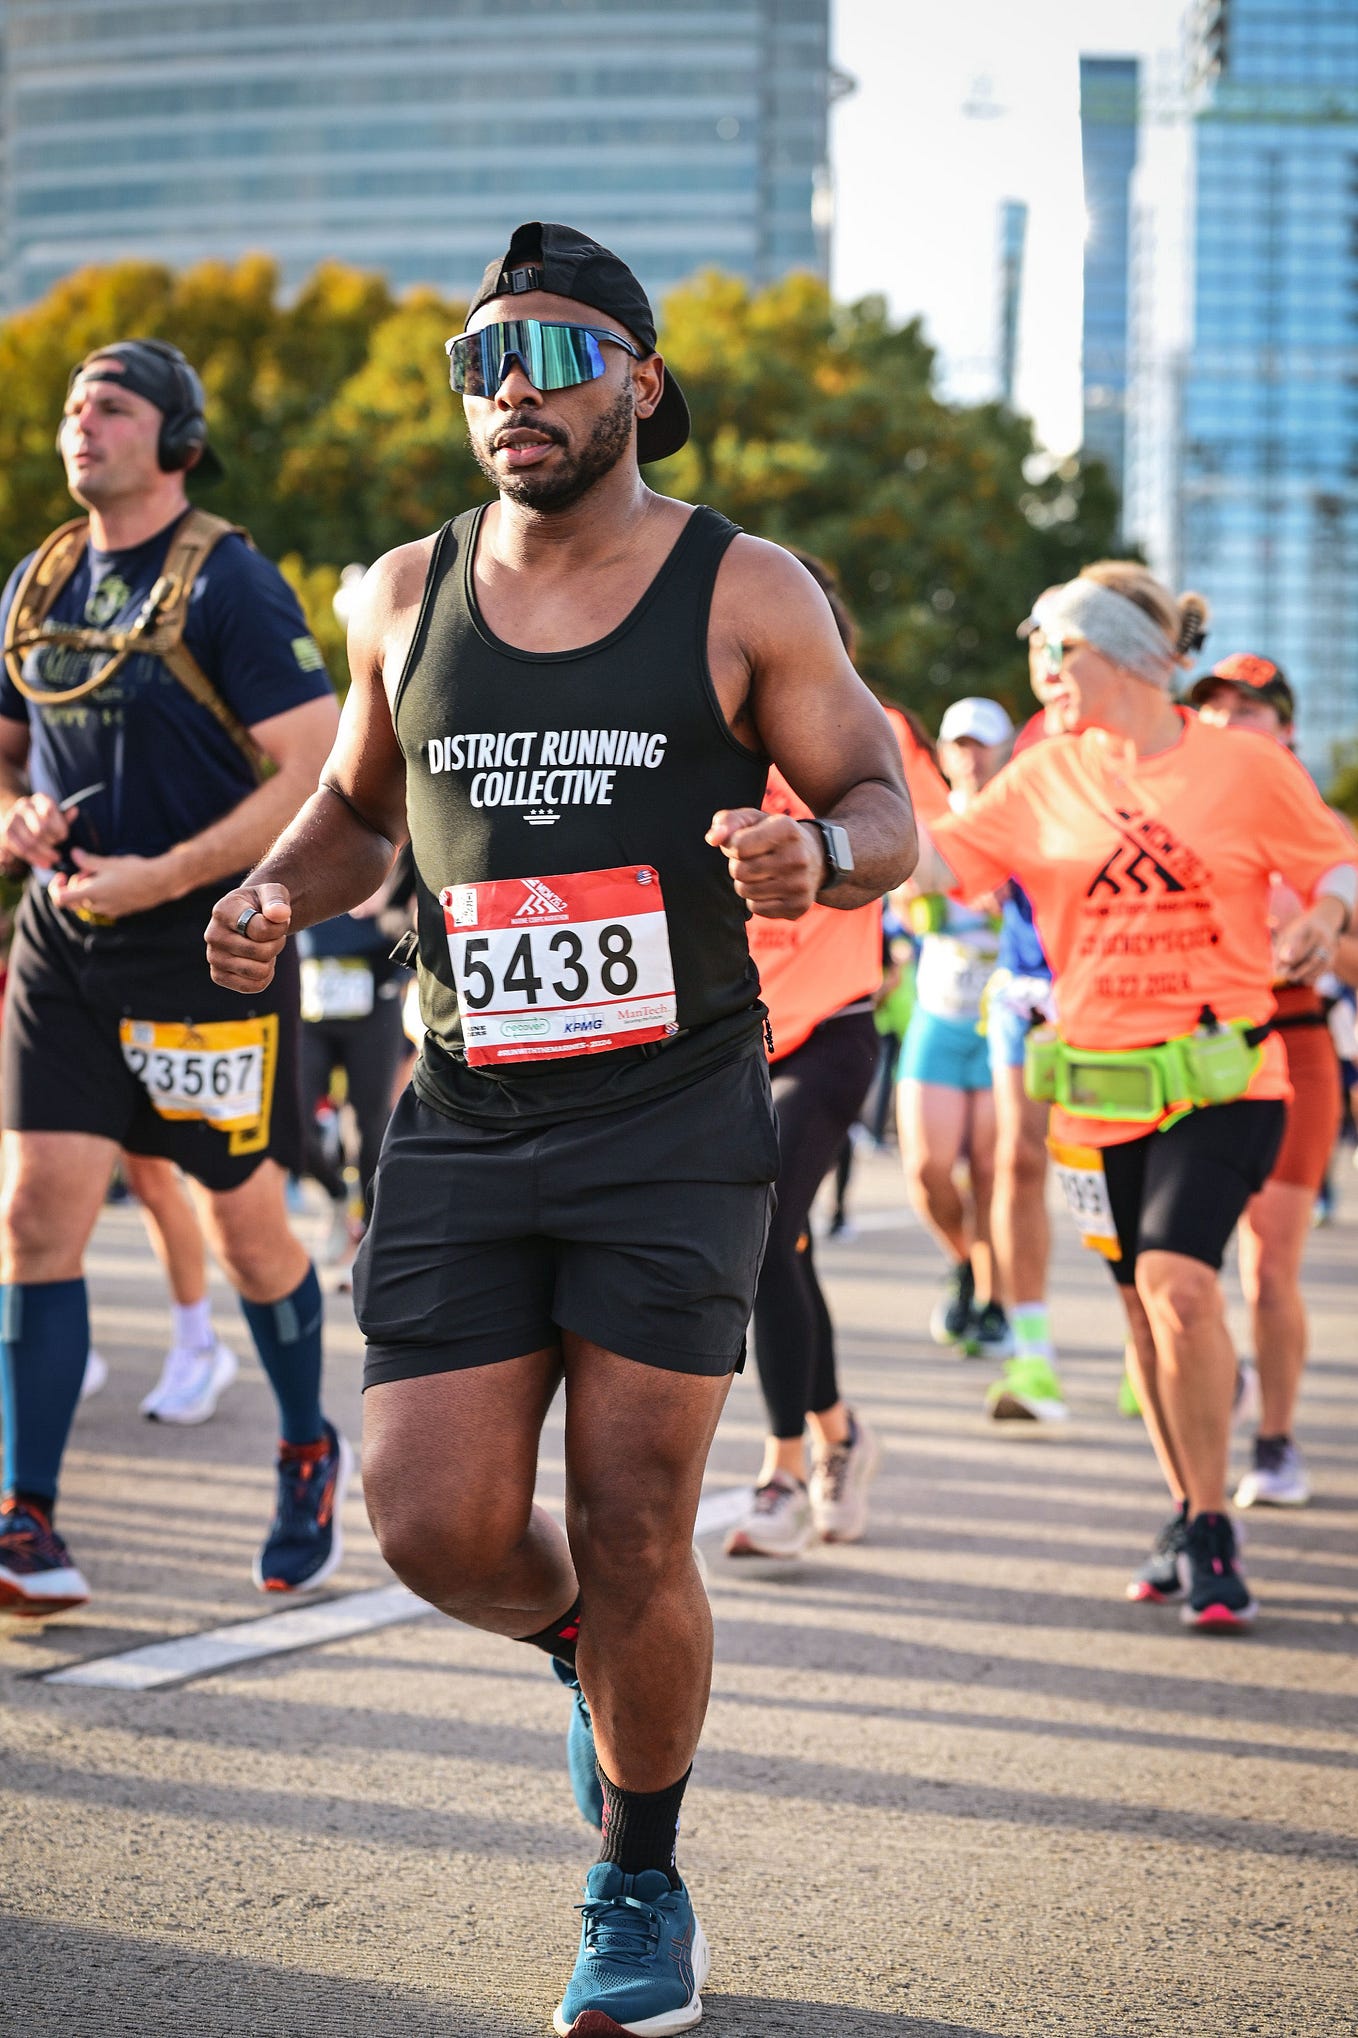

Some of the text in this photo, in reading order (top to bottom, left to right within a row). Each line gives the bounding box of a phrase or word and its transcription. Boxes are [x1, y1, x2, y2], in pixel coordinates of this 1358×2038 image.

[428, 730, 667, 774] DISTRICT RUNNING
[470, 770, 616, 808] COLLECTIVE
[464, 924, 638, 1010] 5438
[504, 1022, 547, 1033] recover
[564, 1019, 604, 1034] KPMG
[617, 1004, 668, 1020] ManTech
[129, 1049, 254, 1096] 23567
